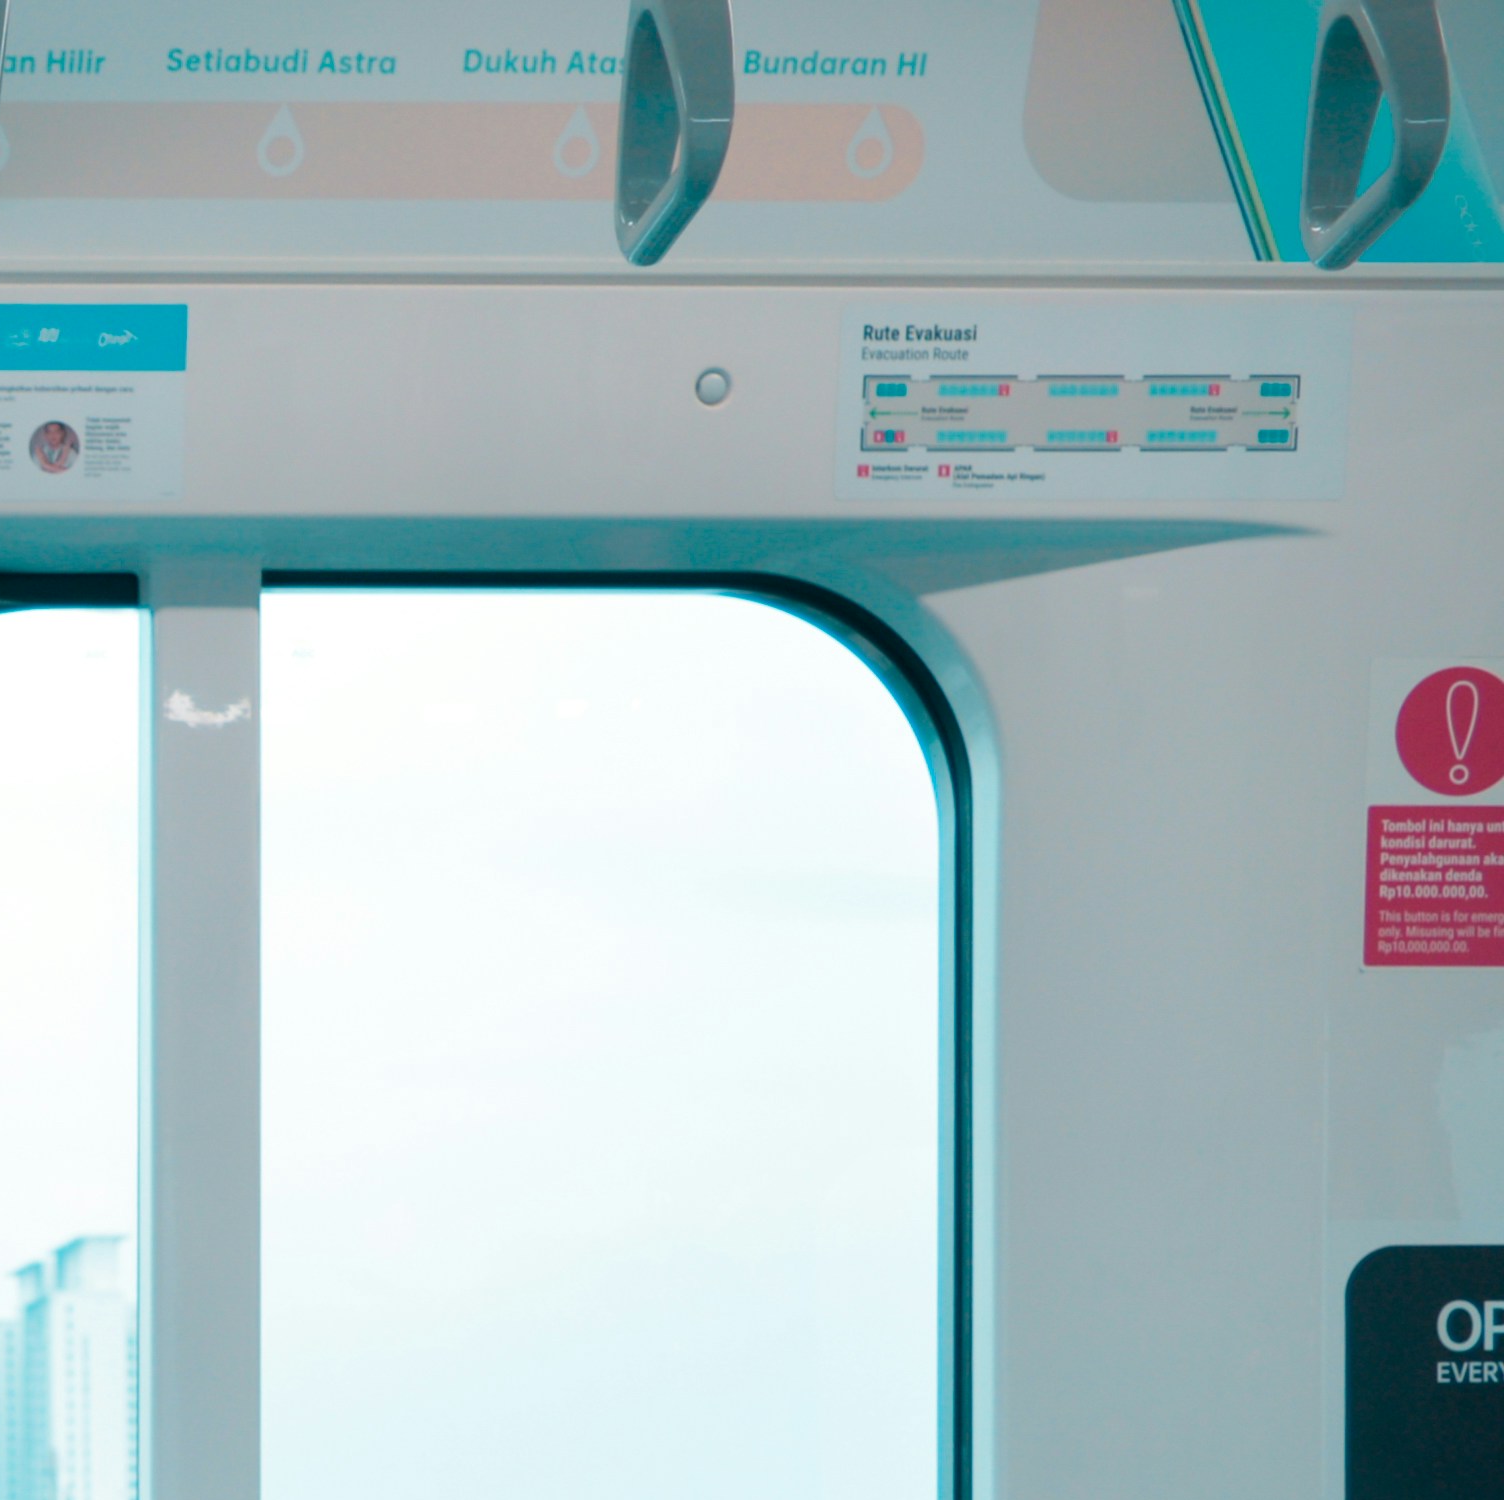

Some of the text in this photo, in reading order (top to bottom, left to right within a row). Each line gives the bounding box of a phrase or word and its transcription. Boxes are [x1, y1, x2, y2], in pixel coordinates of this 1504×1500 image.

[47, 49, 106, 74] Hilir
[167, 48, 396, 74] Setiabudi Astra
[463, 49, 557, 73] Dukuh
[744, 50, 927, 76] Bundaran HI
[863, 324, 978, 341] Rute Evakuasi
[862, 347, 969, 361] Evacuation Route
[1382, 819, 1426, 832] Tombol
[1429, 819, 1444, 832] ini
[1447, 819, 1483, 835] hanya
[1381, 836, 1476, 848] kondisi darurat.
[1381, 852, 1480, 868] Penyalahgunaan
[1380, 868, 1483, 881] dikenakan denda
[1379, 885, 1488, 900] Rp10.000.000,00.
[1379, 910, 1401, 922] This
[1404, 911, 1438, 922] button
[1441, 911, 1450, 922] is
[1453, 911, 1469, 922] for
